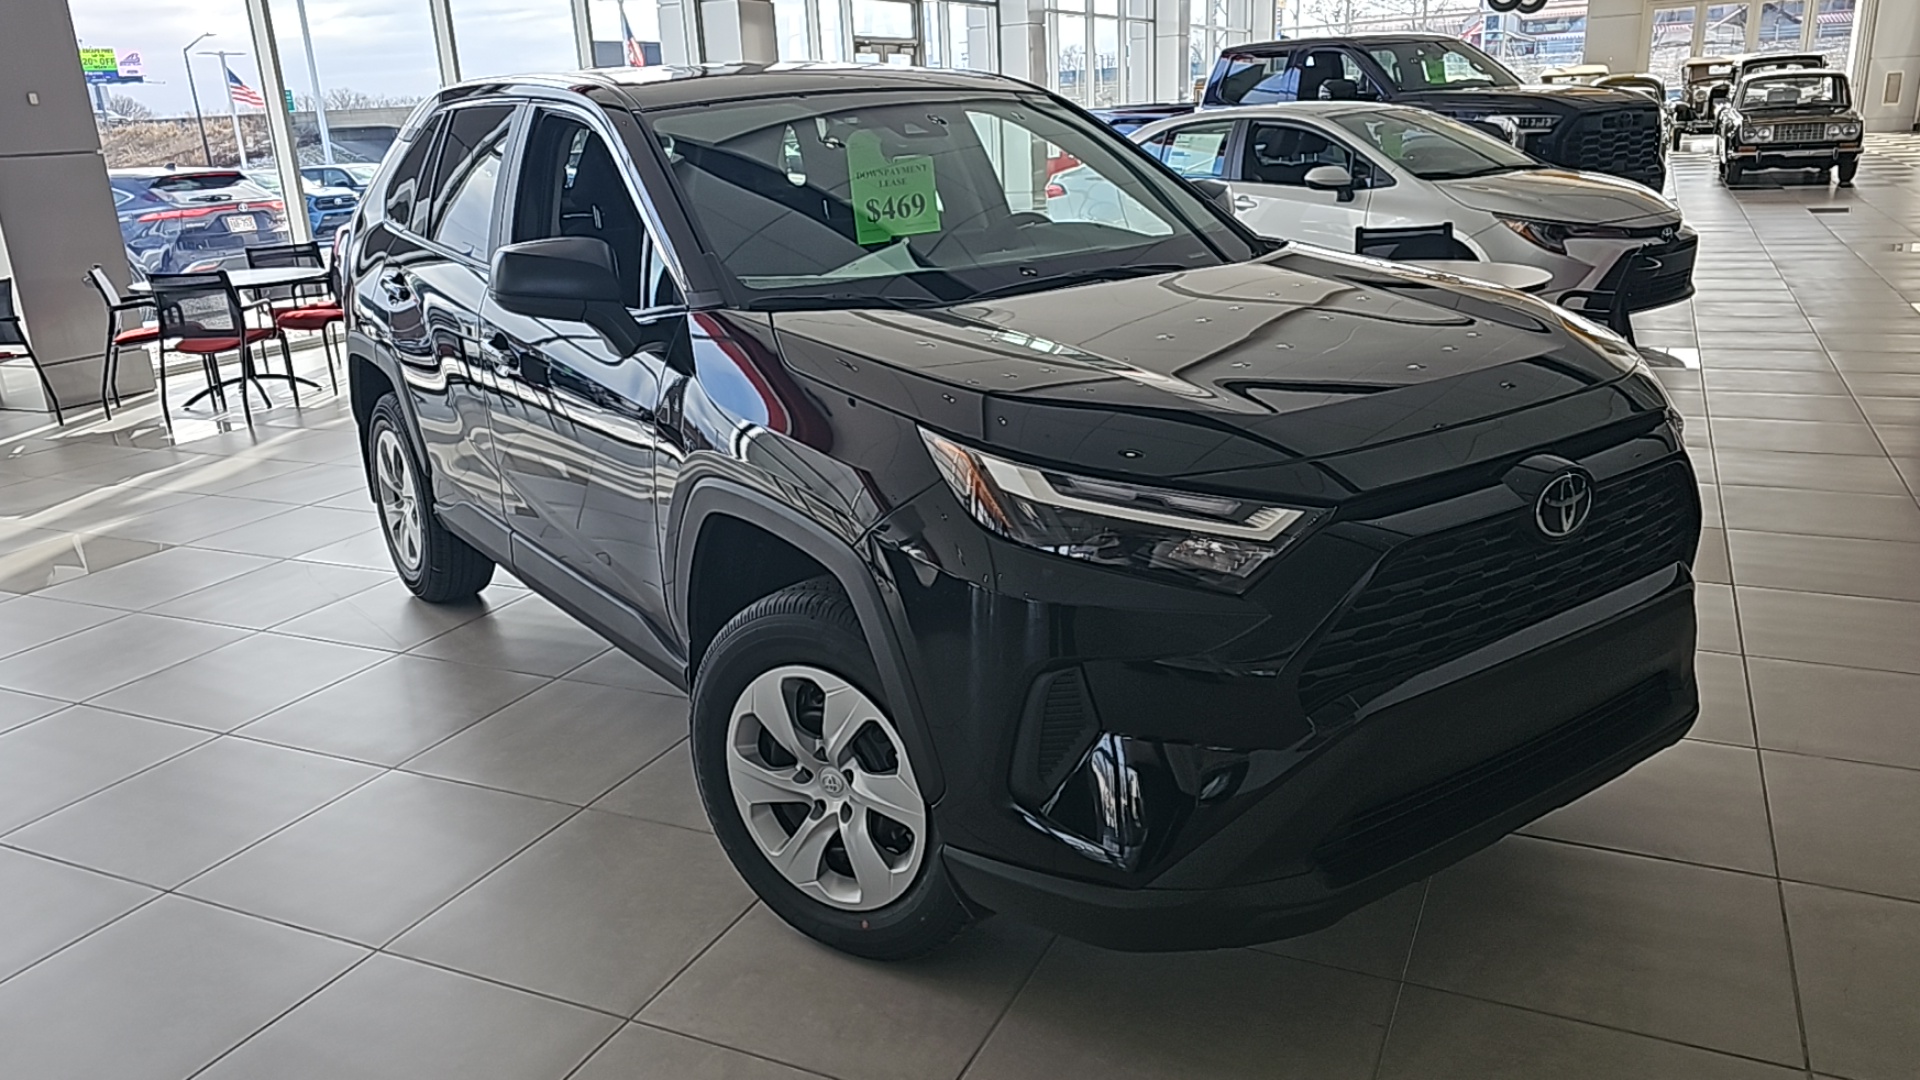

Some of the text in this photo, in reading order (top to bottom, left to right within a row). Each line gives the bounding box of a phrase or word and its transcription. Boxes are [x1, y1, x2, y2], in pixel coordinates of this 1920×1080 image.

[856, 164, 927, 180] DOWNPAYMENT
[879, 178, 906, 188] LEASE
[866, 193, 926, 224] $469
